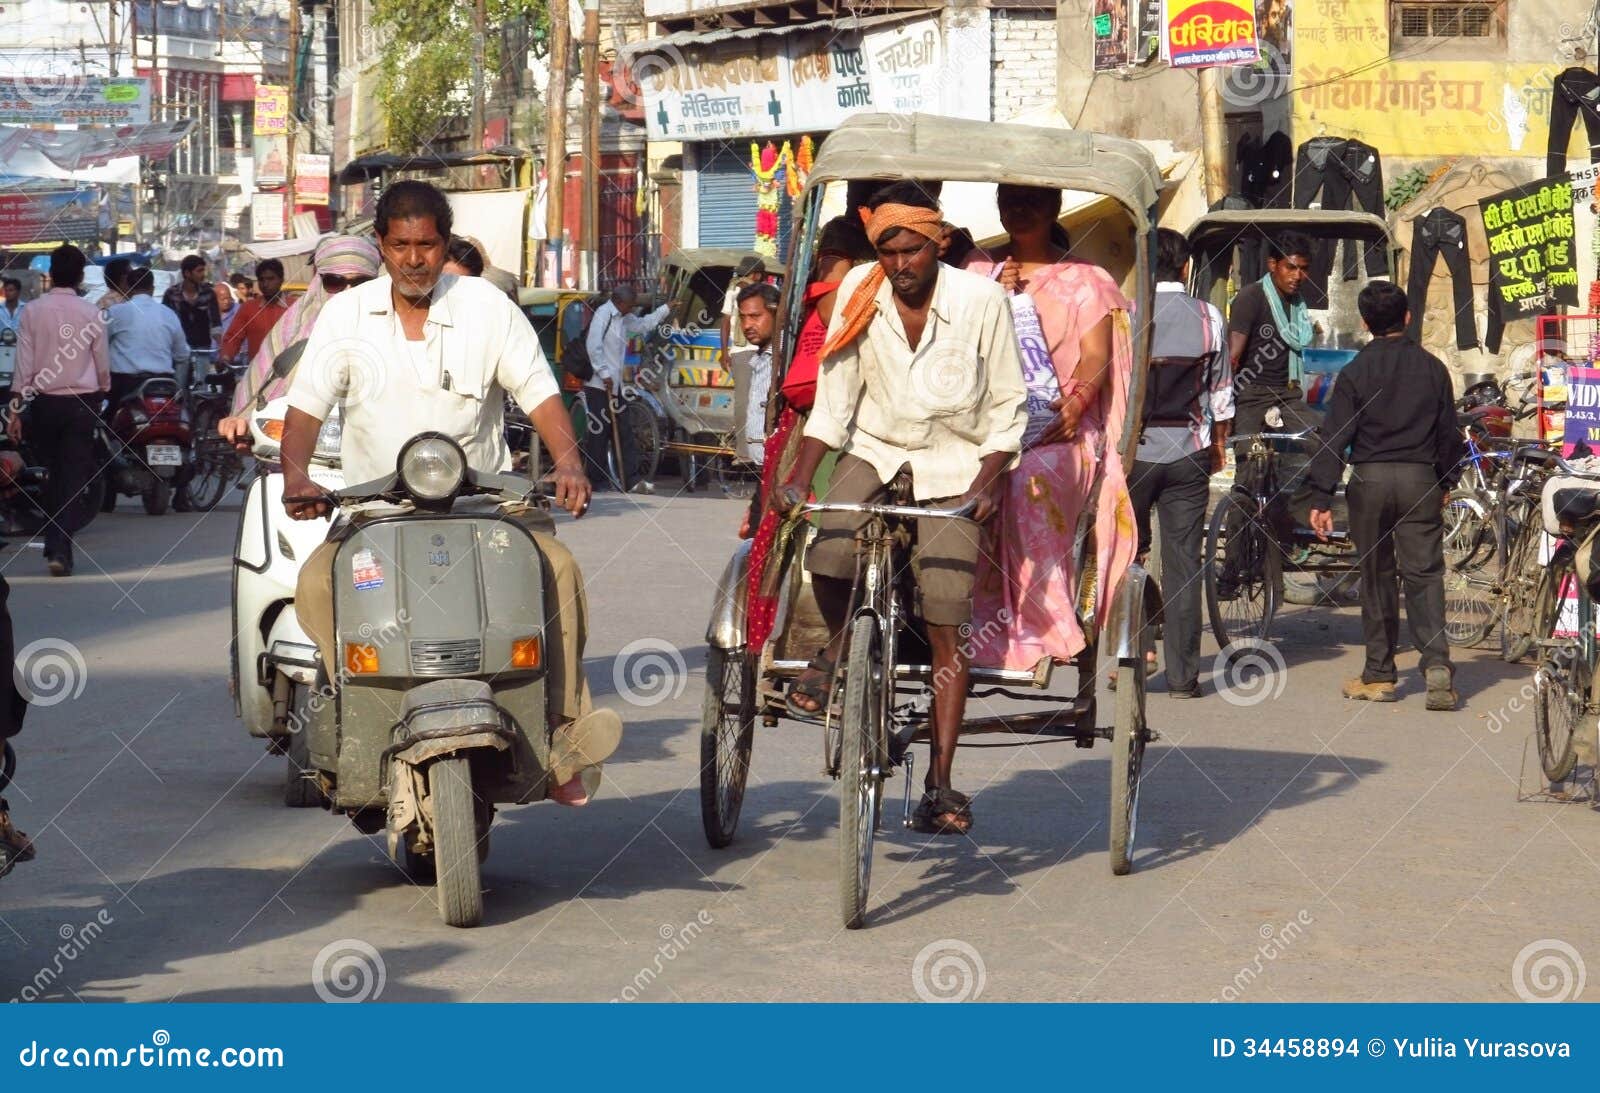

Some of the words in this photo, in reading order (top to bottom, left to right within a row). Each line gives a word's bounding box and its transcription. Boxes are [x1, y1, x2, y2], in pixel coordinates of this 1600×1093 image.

[1170, 14, 1255, 48] परिवार
[681, 93, 742, 118] मेडिकल
[1439, 78, 1486, 116] घर
